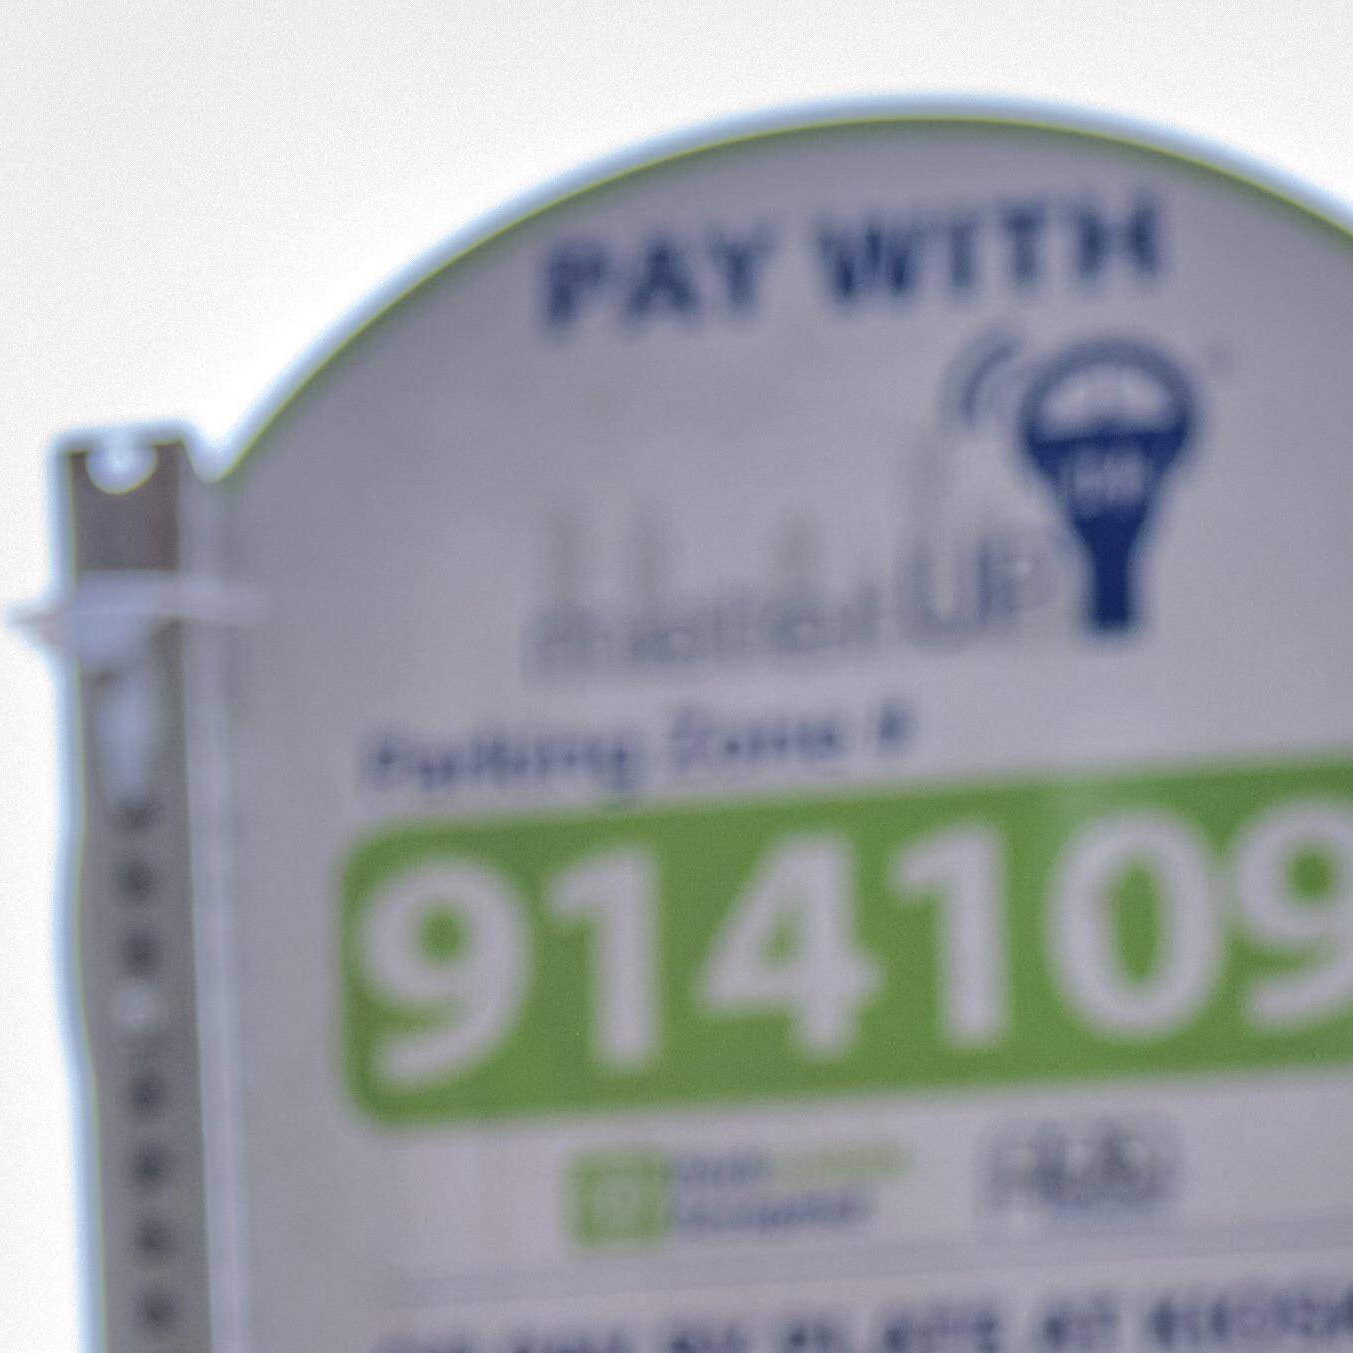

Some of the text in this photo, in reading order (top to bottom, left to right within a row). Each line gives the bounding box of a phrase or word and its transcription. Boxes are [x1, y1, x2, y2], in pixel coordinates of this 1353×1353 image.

[540, 194, 1166, 330] PAY WITH
[362, 798, 1353, 1088] 914109
